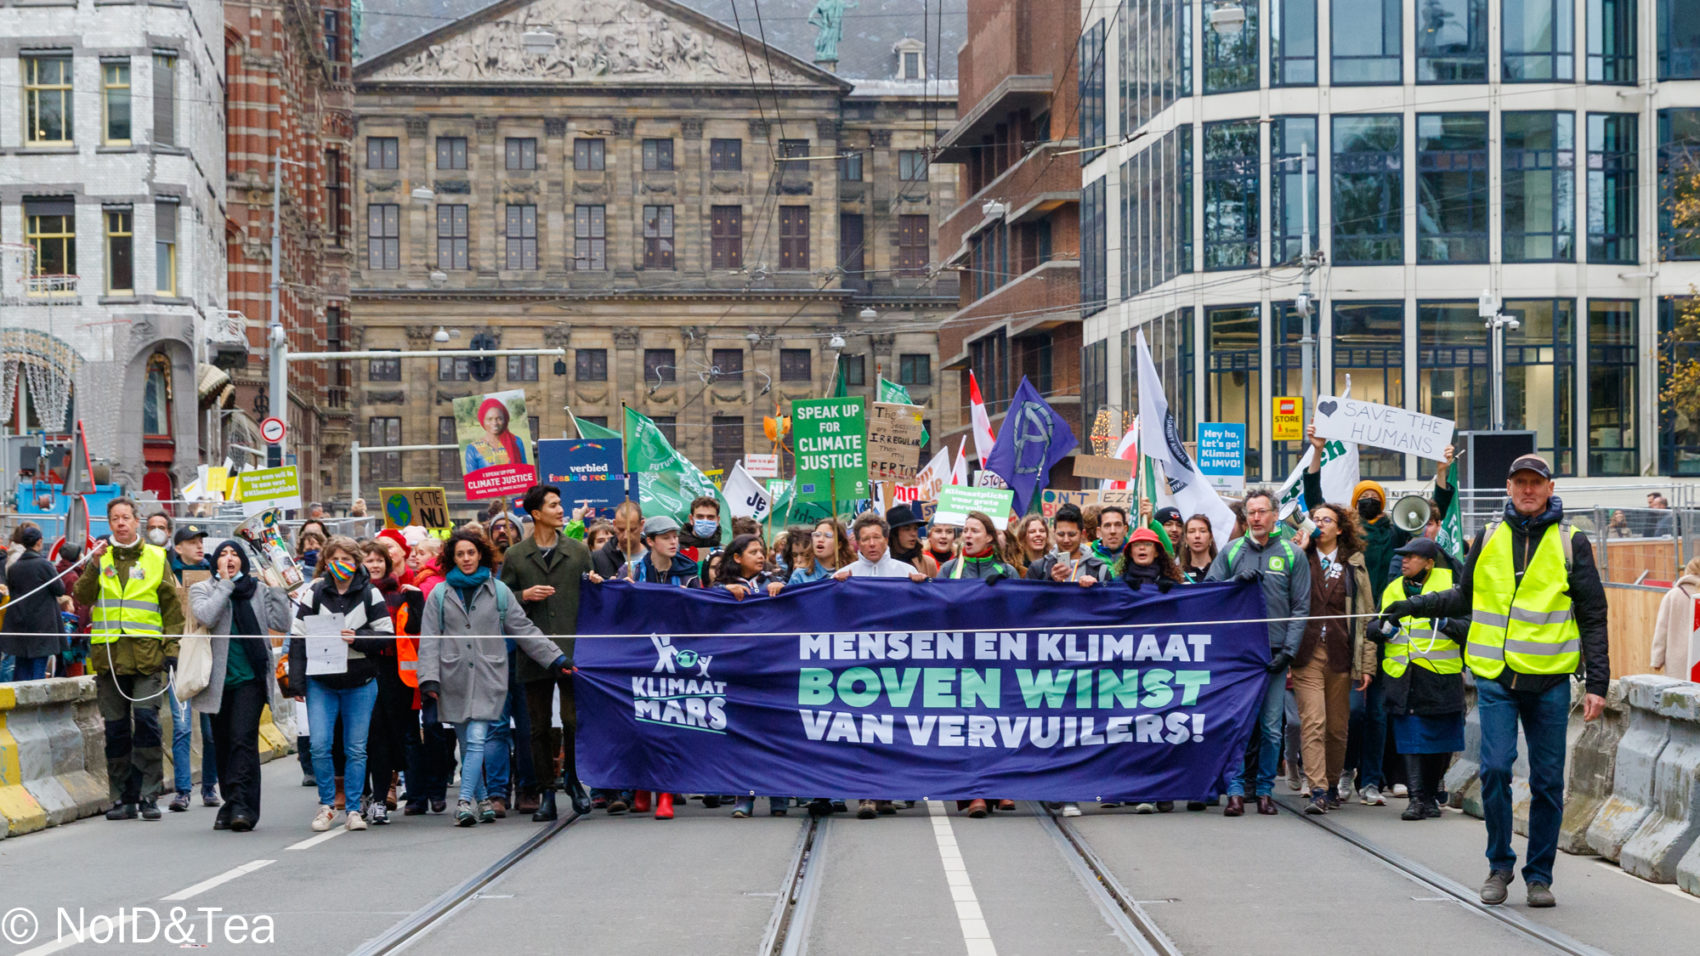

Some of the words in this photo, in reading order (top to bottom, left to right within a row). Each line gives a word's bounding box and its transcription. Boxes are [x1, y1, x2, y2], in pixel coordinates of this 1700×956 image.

[797, 405, 840, 420] SPEAK
[842, 404, 859, 418] UP
[875, 406, 896, 419] The
[1274, 415, 1300, 423] STORE
[1344, 402, 1398, 424] SAVE
[1407, 413, 1442, 435] THE
[819, 422, 840, 433] FOR
[1204, 429, 1223, 439] Hey
[1224, 429, 1239, 439] ho,
[799, 435, 862, 452] CLIMATE
[870, 433, 921, 447] IRREGULAR
[1202, 440, 1224, 448] Let's
[1225, 440, 1240, 450] go!
[1351, 422, 1433, 454] HUMANS
[1201, 449, 1240, 458] Klimaat
[569, 463, 608, 473] verbied
[649, 456, 676, 471] FUTUR
[801, 453, 863, 470] JUSTICE
[1201, 459, 1210, 467] in
[1212, 459, 1241, 468] IMVO!
[242, 475, 260, 483] Waar
[467, 477, 501, 490] CLIMATE
[501, 472, 534, 485] JUSTICE
[549, 473, 588, 482] fossiele
[413, 491, 443, 506] ACTIE
[951, 496, 972, 504] voor
[974, 498, 999, 507] grote
[924, 503, 938, 516] ST
[420, 508, 445, 528] NU
[800, 632, 963, 660] MENSEN
[975, 633, 1014, 661] EN
[1039, 633, 1212, 662] KLIMAAT
[632, 677, 727, 698] KLIMAAT
[799, 666, 1000, 708] BOVEN
[1017, 667, 1211, 709] WINST
[635, 697, 727, 730] MARS
[800, 709, 894, 744] VAN
[905, 713, 1206, 749] VERVUILERS!
